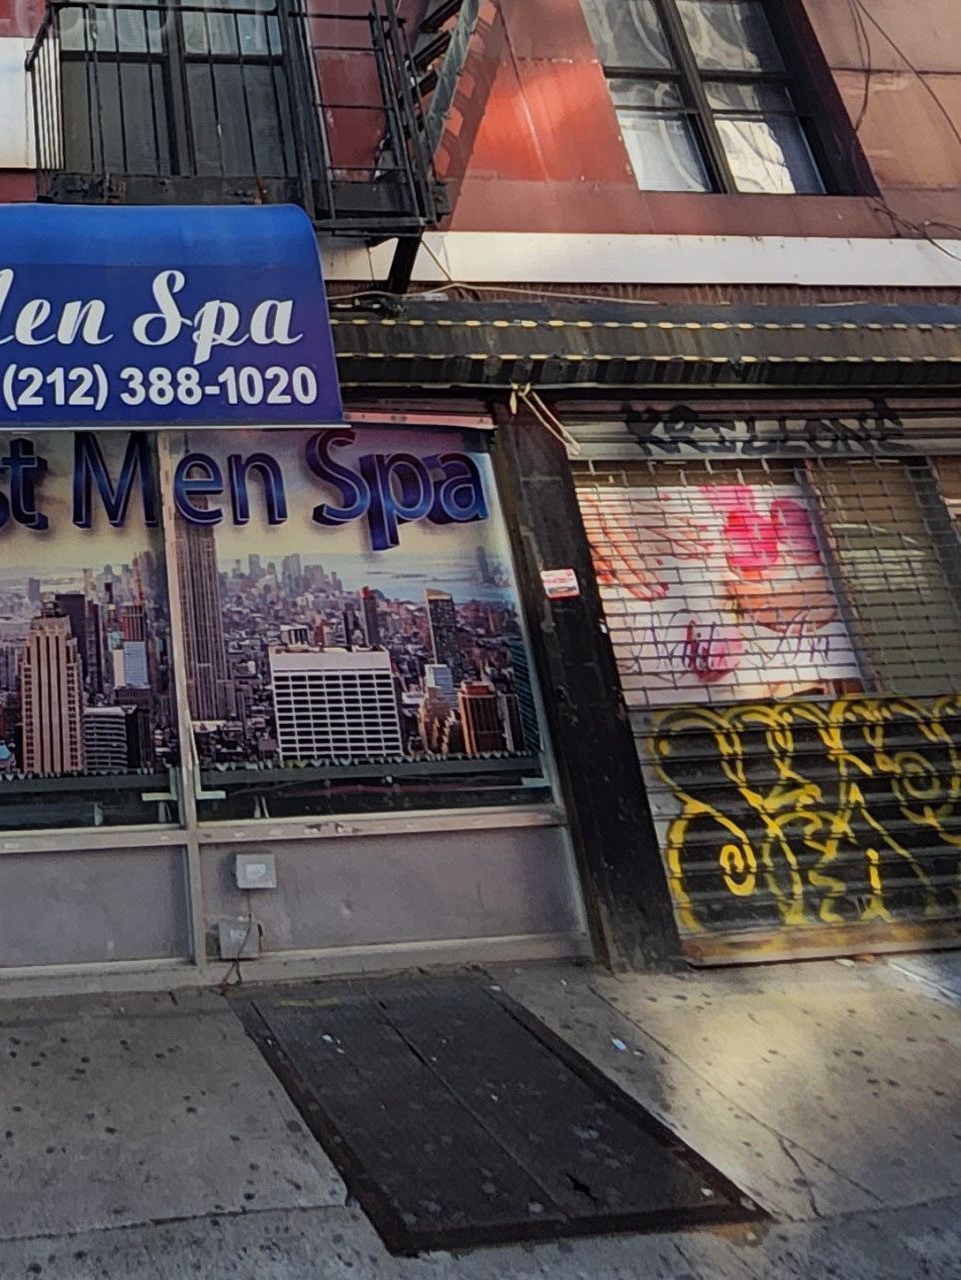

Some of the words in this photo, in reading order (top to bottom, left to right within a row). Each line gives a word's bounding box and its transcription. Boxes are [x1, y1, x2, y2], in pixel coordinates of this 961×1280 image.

[132, 269, 303, 364] Spa
[2, 364, 108, 411] (212)
[119, 365, 318, 405] 388-1020
[69, 431, 289, 529] Men
[312, 430, 490, 552] Spa
